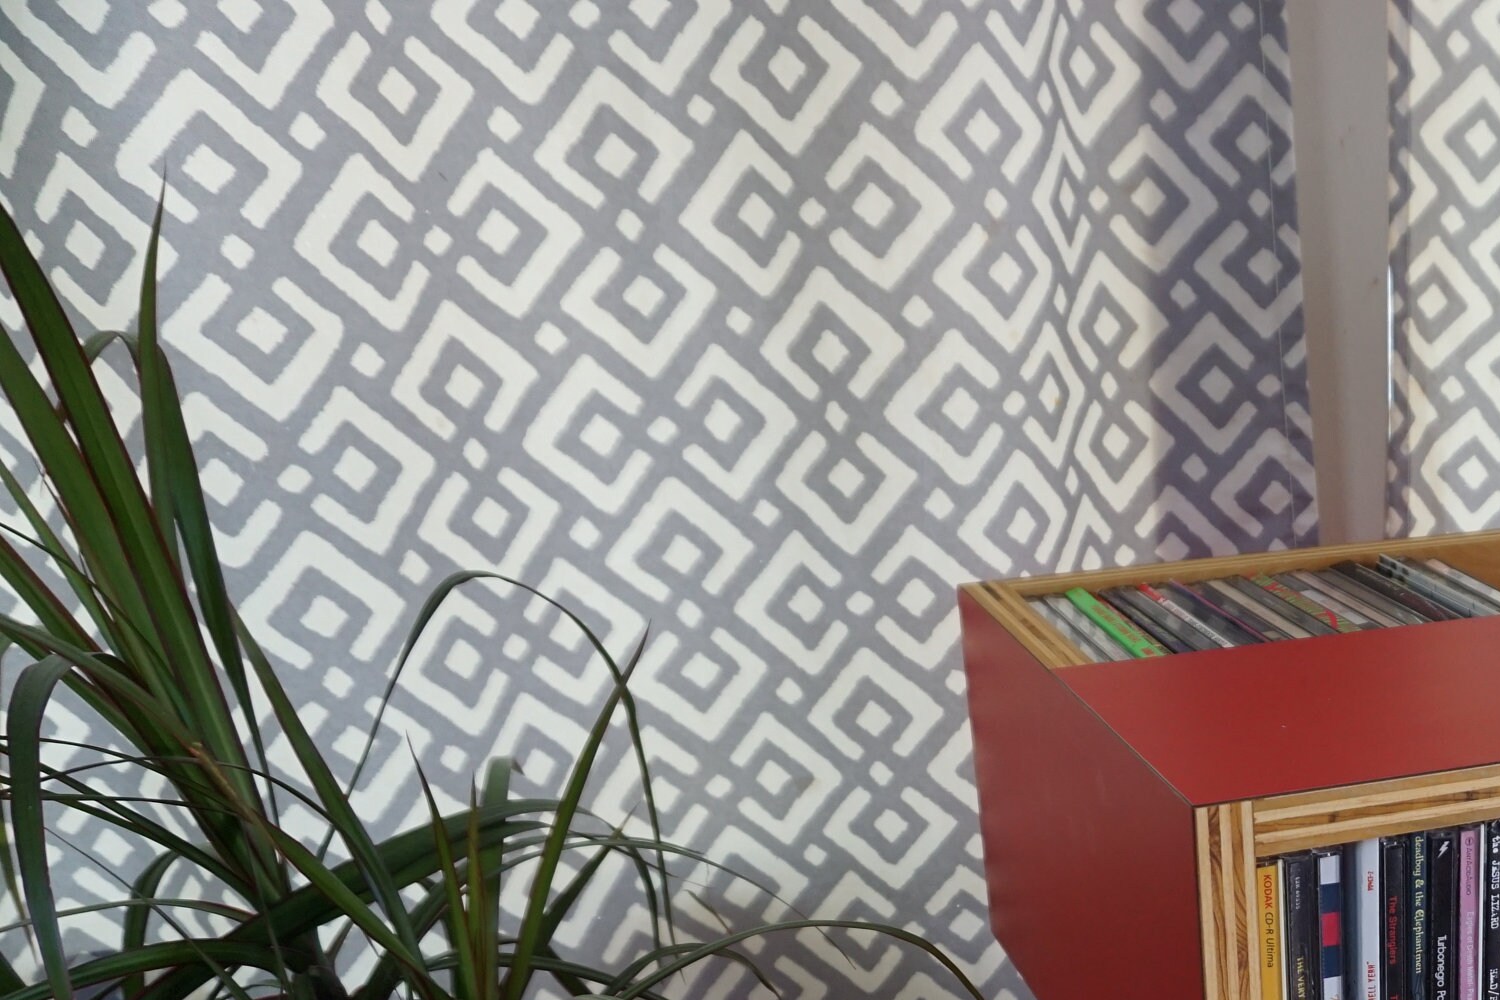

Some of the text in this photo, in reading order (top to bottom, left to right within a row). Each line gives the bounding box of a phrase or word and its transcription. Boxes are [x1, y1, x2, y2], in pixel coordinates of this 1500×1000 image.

[1413, 836, 1424, 974] deadboy & the Elephantmen
[1490, 835, 1500, 930] the JESUS LIZARD
[1263, 874, 1276, 968] KODAK CD-R Ultima
[1387, 896, 1398, 965] The Stranglers
[1465, 911, 1474, 934] Eagles
[1296, 956, 1304, 975] THE
[1434, 934, 1447, 987] Turbonegro
[1466, 944, 1474, 964] Death
[1297, 976, 1305, 998] VERY
